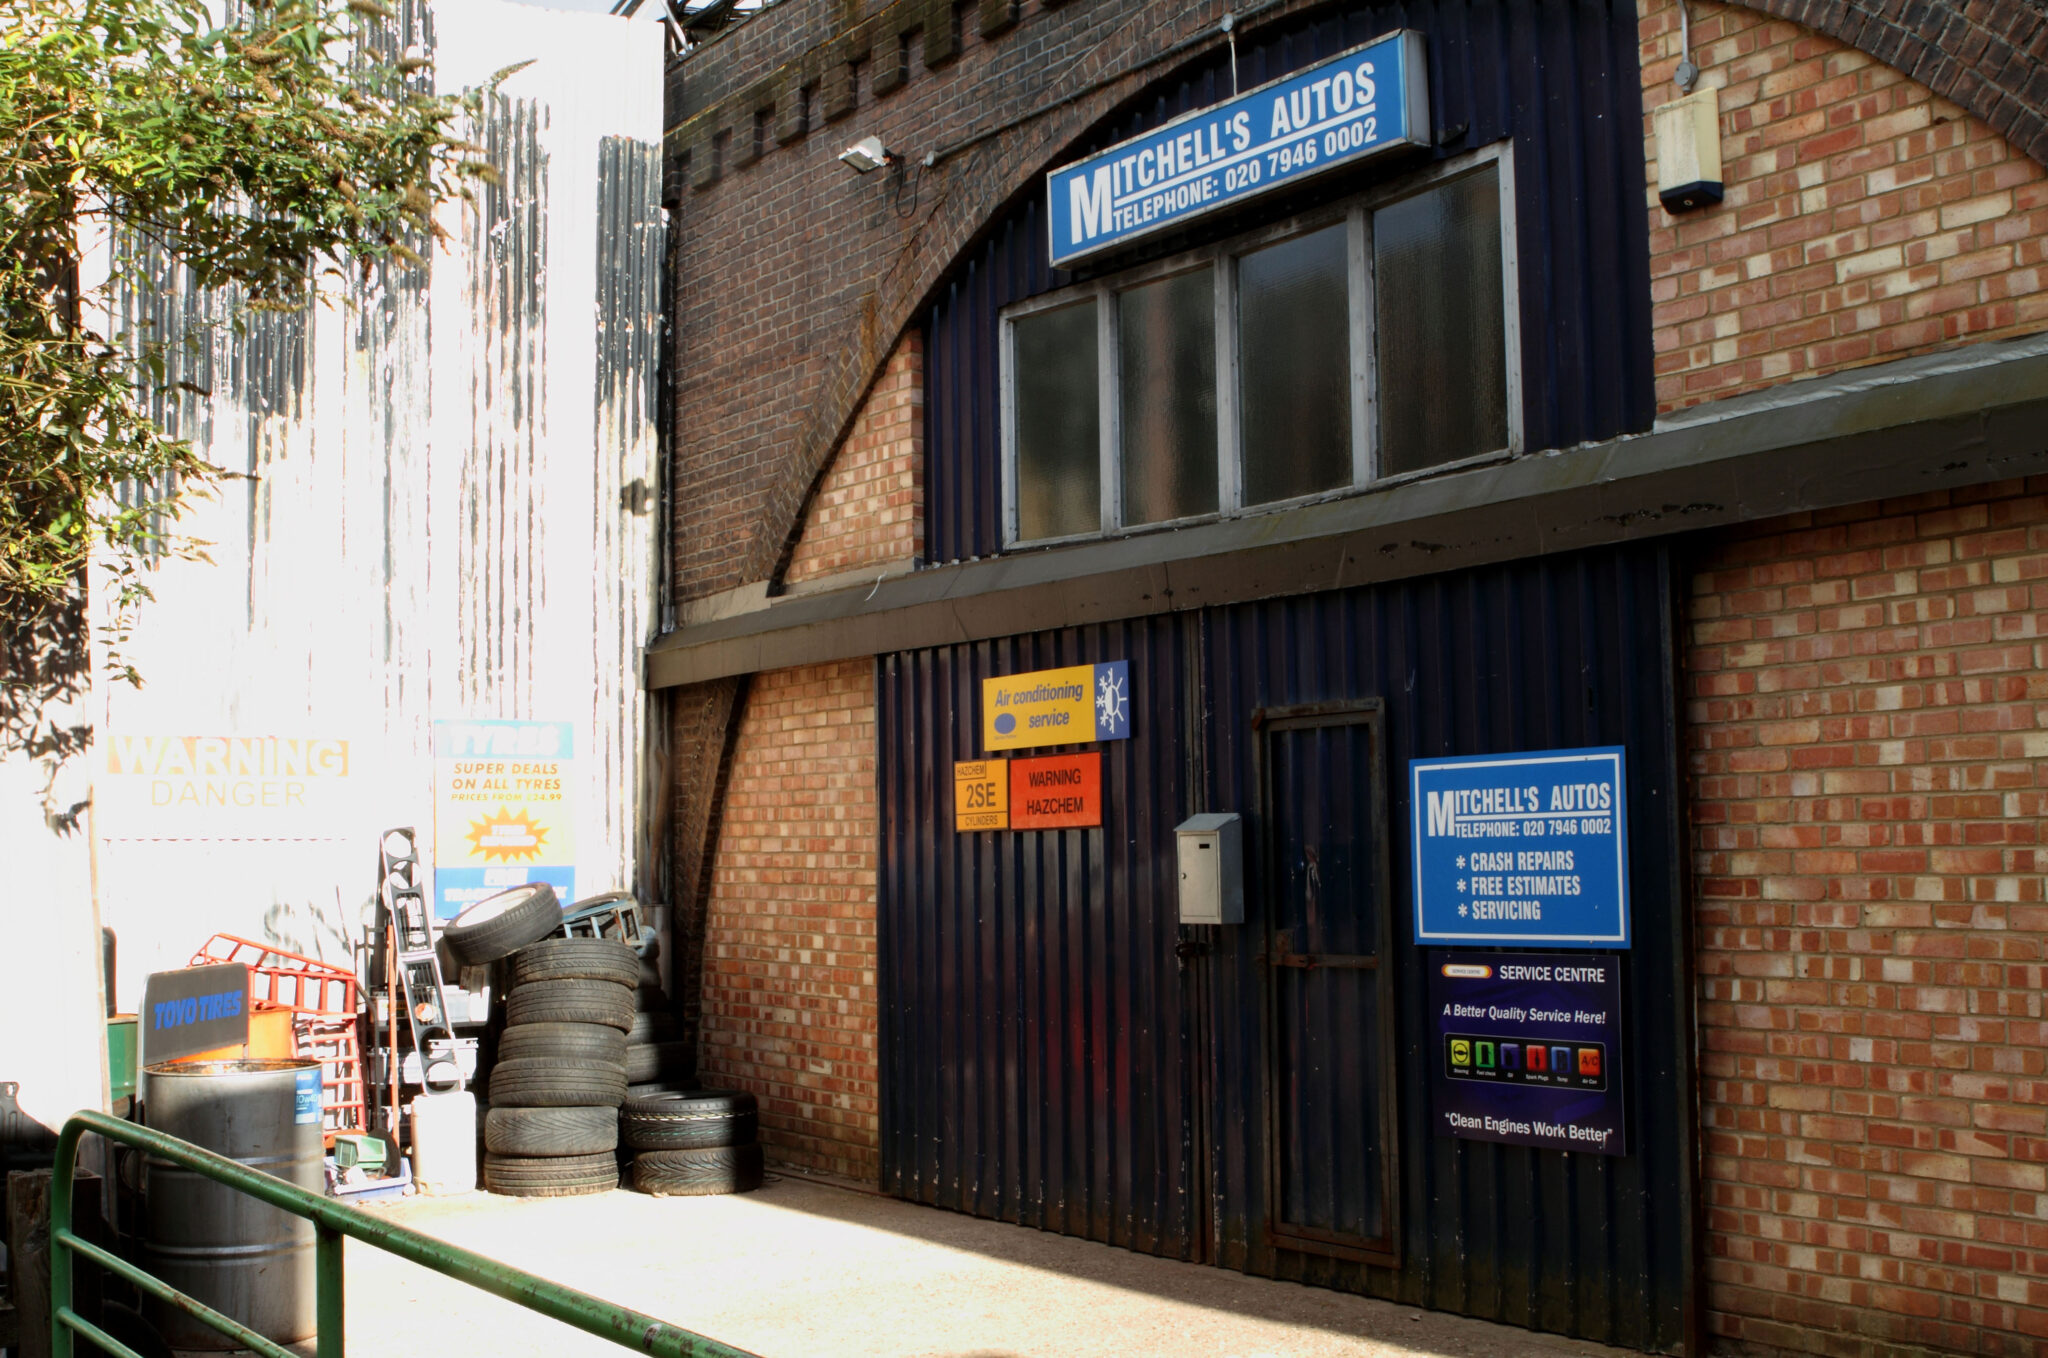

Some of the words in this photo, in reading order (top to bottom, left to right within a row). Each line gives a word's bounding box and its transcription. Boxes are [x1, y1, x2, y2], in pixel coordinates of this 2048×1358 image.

[1069, 110, 1251, 245] MITCHELL'S
[1270, 62, 1376, 138] AUTOS
[1112, 179, 1219, 232] TELEPHONE:
[1225, 159, 1261, 192] 020
[1267, 138, 1317, 177] 7946
[1325, 117, 1377, 156] 0002
[995, 689, 1010, 707] Air
[1013, 681, 1083, 705] conditioning
[1029, 708, 1070, 729] service
[110, 737, 346, 776] WARNING
[454, 763, 505, 774] SUPER
[511, 763, 558, 775] DEALS
[957, 764, 985, 776] HAZCHEM
[1029, 768, 1081, 787] WARNING
[151, 780, 306, 807] DANGER
[452, 778, 476, 790] ON
[483, 778, 509, 790] ALL
[516, 778, 561, 790] TYRES
[451, 793, 488, 801] PRICES
[492, 793, 522, 801] FROM
[966, 782, 996, 808] 2SE
[1026, 797, 1084, 816] HAZCHEM
[1427, 786, 1539, 837] MITCHELL'S
[1551, 782, 1611, 810] AUTOS
[965, 814, 998, 826] CYLINDERS
[1455, 821, 1520, 838] TELEPHONE:
[1523, 820, 1545, 835] 020
[1549, 819, 1578, 834] 7946
[1581, 818, 1612, 834] 0002
[1470, 852, 1514, 871] CRASH
[1517, 850, 1575, 870] REPAIRS
[1471, 876, 1504, 895] FREE
[1507, 875, 1581, 895] ESTIMATES
[1472, 900, 1541, 920] SERVICING
[1500, 965, 1552, 981] SERVICE
[1554, 967, 1606, 983] CENTRE
[154, 997, 197, 1030] TOYO
[199, 990, 243, 1021] TIRES
[1443, 1004, 1451, 1016] A
[1454, 1004, 1486, 1018] Better
[1489, 1006, 1527, 1022] Quality
[1529, 1008, 1571, 1022] Service
[1574, 1010, 1606, 1024] Here!
[1581, 1057, 1599, 1066] A/C
[1445, 1112, 1482, 1129] “Clean
[1485, 1116, 1530, 1134] Engines
[1533, 1121, 1566, 1138] Work
